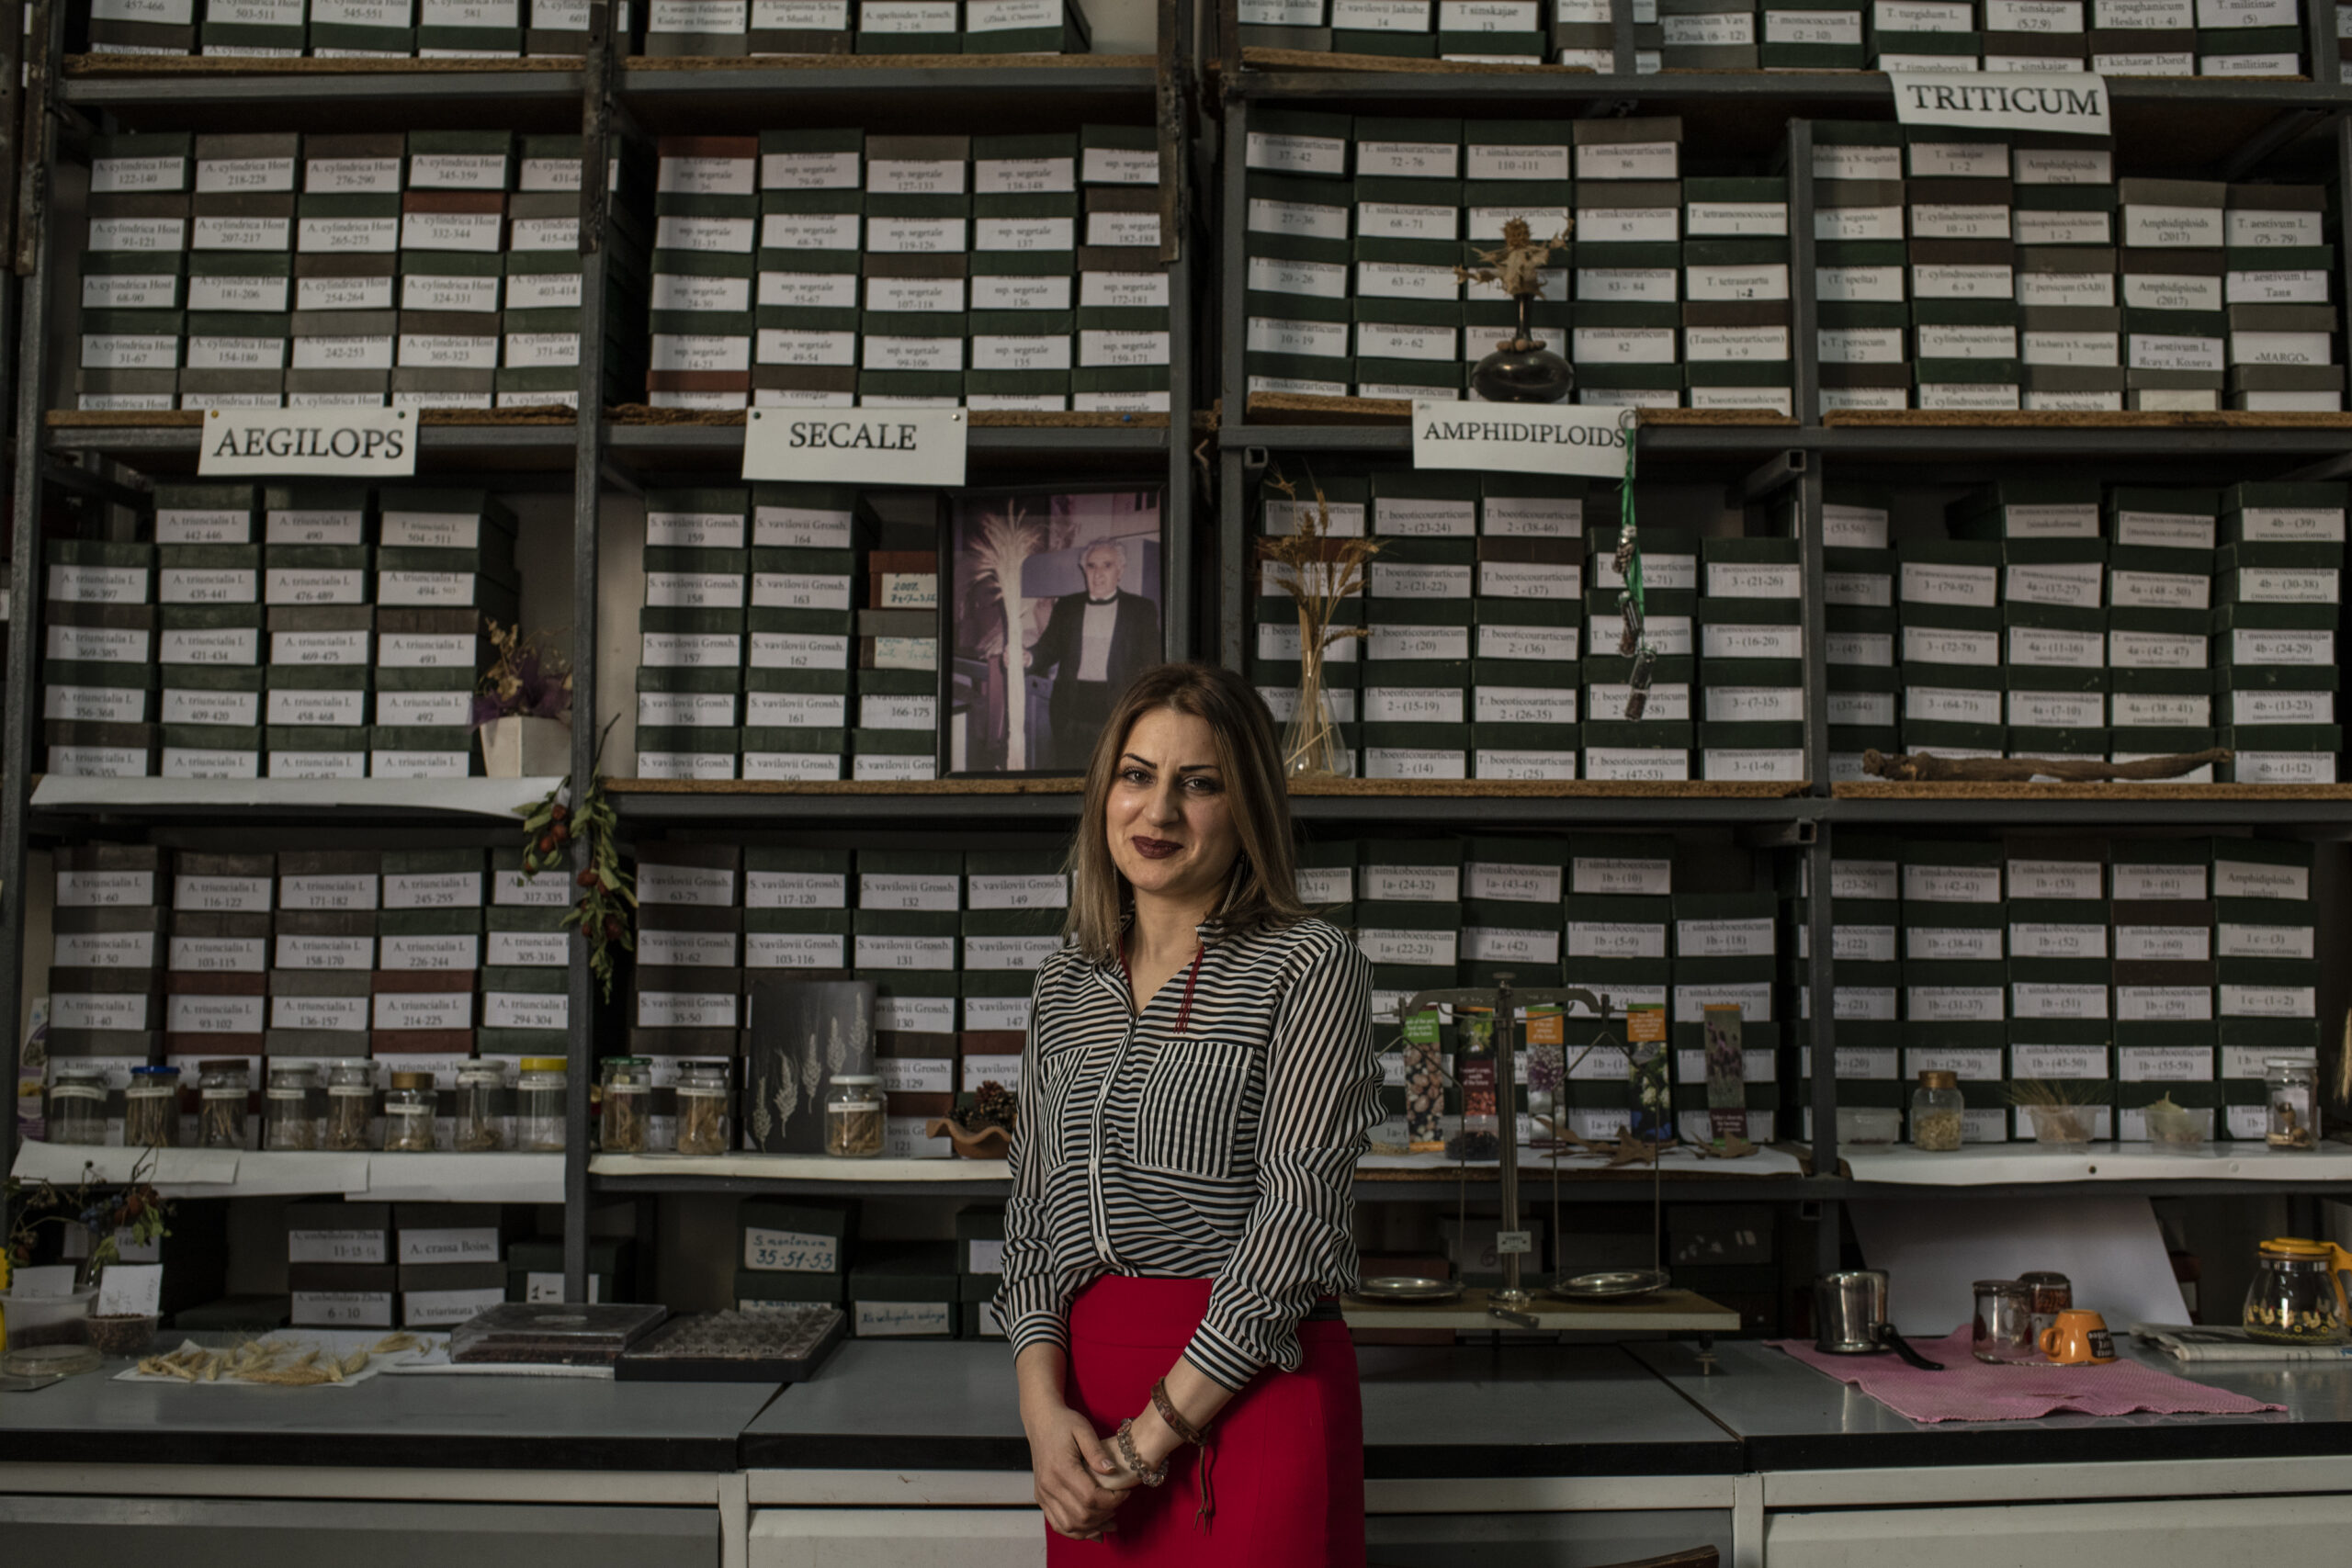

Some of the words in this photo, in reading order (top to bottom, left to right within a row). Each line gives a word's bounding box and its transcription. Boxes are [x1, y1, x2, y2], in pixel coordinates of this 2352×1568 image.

[235, 8, 274, 19] 503-511
[344, 8, 381, 17] 545-551
[464, 8, 480, 17] 581
[1469, 5, 1519, 17] sinskajae
[1887, 9, 1896, 17] T.
[1899, 10, 1947, 19] turgidum
[1949, 9, 1958, 19] L.
[2218, 60, 2228, 69] T.
[2232, 61, 2278, 69] militinae
[1906, 84, 2098, 115] TRITICUM
[96, 163, 107, 171] A.
[108, 162, 155, 171] cylindrica
[158, 161, 180, 169] Host
[205, 164, 215, 172] A.
[219, 163, 266, 172] cylindrica
[1498, 161, 1515, 169] 110
[119, 174, 157, 184] 122-140
[228, 174, 266, 185] 218-228
[438, 171, 478, 179] 345-359
[336, 175, 375, 185] 276-290
[898, 181, 933, 190] 127-133
[2140, 220, 2208, 228] Amphidiploids
[2237, 220, 2247, 228] T.
[2298, 220, 2307, 228] L.
[221, 232, 260, 243] 207-217
[433, 229, 470, 238] 332-344
[2158, 231, 2189, 241] (2017)
[122, 237, 155, 246] 91-121
[331, 234, 369, 244] 265-275
[1017, 239, 1033, 247] 137
[897, 242, 937, 251] 119-126
[537, 287, 576, 295] 403-414
[2139, 283, 2207, 292] Amphidiploids
[325, 291, 364, 302] 254-264
[434, 292, 470, 303] 324-331
[794, 294, 820, 303] 55-67
[1112, 295, 1147, 304] 172-181
[2156, 296, 2188, 305] (2017)
[898, 300, 933, 309] 107-118
[537, 345, 574, 356] 371-402
[1618, 343, 1629, 351] 82
[325, 346, 364, 358] 242-253
[431, 351, 469, 360] 305-323
[119, 353, 147, 363] 31-67
[219, 352, 258, 362] 154-180
[1112, 354, 1149, 364] 159-171
[2254, 353, 2309, 363] «MARGO»
[1014, 358, 1030, 367] 135
[789, 423, 917, 450] SECALE
[1424, 423, 1627, 446] AMPHIDIPLOIDS
[214, 427, 403, 458] AEGILOPS
[1376, 510, 1386, 518] T.
[769, 521, 809, 529] vavilovii
[812, 522, 847, 530] Grossh.
[1398, 523, 1405, 533] 2
[1414, 522, 1452, 533] (23-24)
[1507, 522, 1512, 532] 2
[1521, 522, 1558, 533] (38-46)
[185, 531, 221, 539] 442-446
[687, 533, 704, 542] 159
[173, 576, 183, 584] A.
[187, 576, 235, 584] triuncialis
[189, 590, 226, 598] 435-441
[295, 592, 334, 600] 476-489
[687, 593, 703, 603] 158
[794, 595, 809, 604] 163
[190, 650, 228, 660] 421-434
[300, 651, 339, 660] 469-475
[419, 655, 435, 663] 493
[684, 653, 700, 662] 157
[790, 656, 807, 665] 162
[191, 711, 229, 720] 409-420
[891, 706, 930, 716] 166-175
[416, 713, 433, 721] 492
[678, 713, 695, 722] 156
[788, 714, 803, 722] 161
[748, 879, 757, 888] S.
[762, 880, 804, 888] vavilovii
[806, 879, 842, 888] Grossh.
[1398, 879, 1435, 889] (24-32)
[2227, 874, 2294, 886] Amphidiploids
[292, 882, 302, 890] A.
[90, 893, 119, 902] 51-60
[415, 893, 453, 903] 245-255
[524, 892, 562, 901] 317-335
[670, 891, 698, 900] 63-75
[777, 894, 816, 904] 117-120
[1011, 895, 1027, 904] 149
[204, 897, 242, 908] 116-122
[310, 896, 347, 906] 171-182
[902, 897, 918, 907] 132
[90, 953, 119, 964] 41-50
[198, 957, 235, 966] 103-115
[306, 955, 344, 965] 158-170
[410, 957, 448, 966] 226-244
[517, 952, 555, 962] 305-316
[673, 953, 700, 962] 51-62
[775, 954, 814, 964] 103-116
[897, 955, 912, 964] 131
[1007, 957, 1023, 965] 148
[84, 1016, 112, 1025] 31-40
[300, 1016, 338, 1026] 136-157
[403, 1015, 442, 1025] 214-225
[513, 1015, 551, 1023] 294-304
[673, 1012, 701, 1022] 35-50
[1007, 1016, 1023, 1026] 147
[198, 1019, 232, 1029] 93-102
[895, 1019, 913, 1027] 130
[882, 1077, 922, 1089] 122-129
[753, 1235, 763, 1245] S.
[410, 1245, 422, 1254] A.
[425, 1244, 458, 1253] crassa
[461, 1242, 492, 1252] Boiss.
[327, 1307, 335, 1319] 6
[347, 1307, 360, 1319] 10
